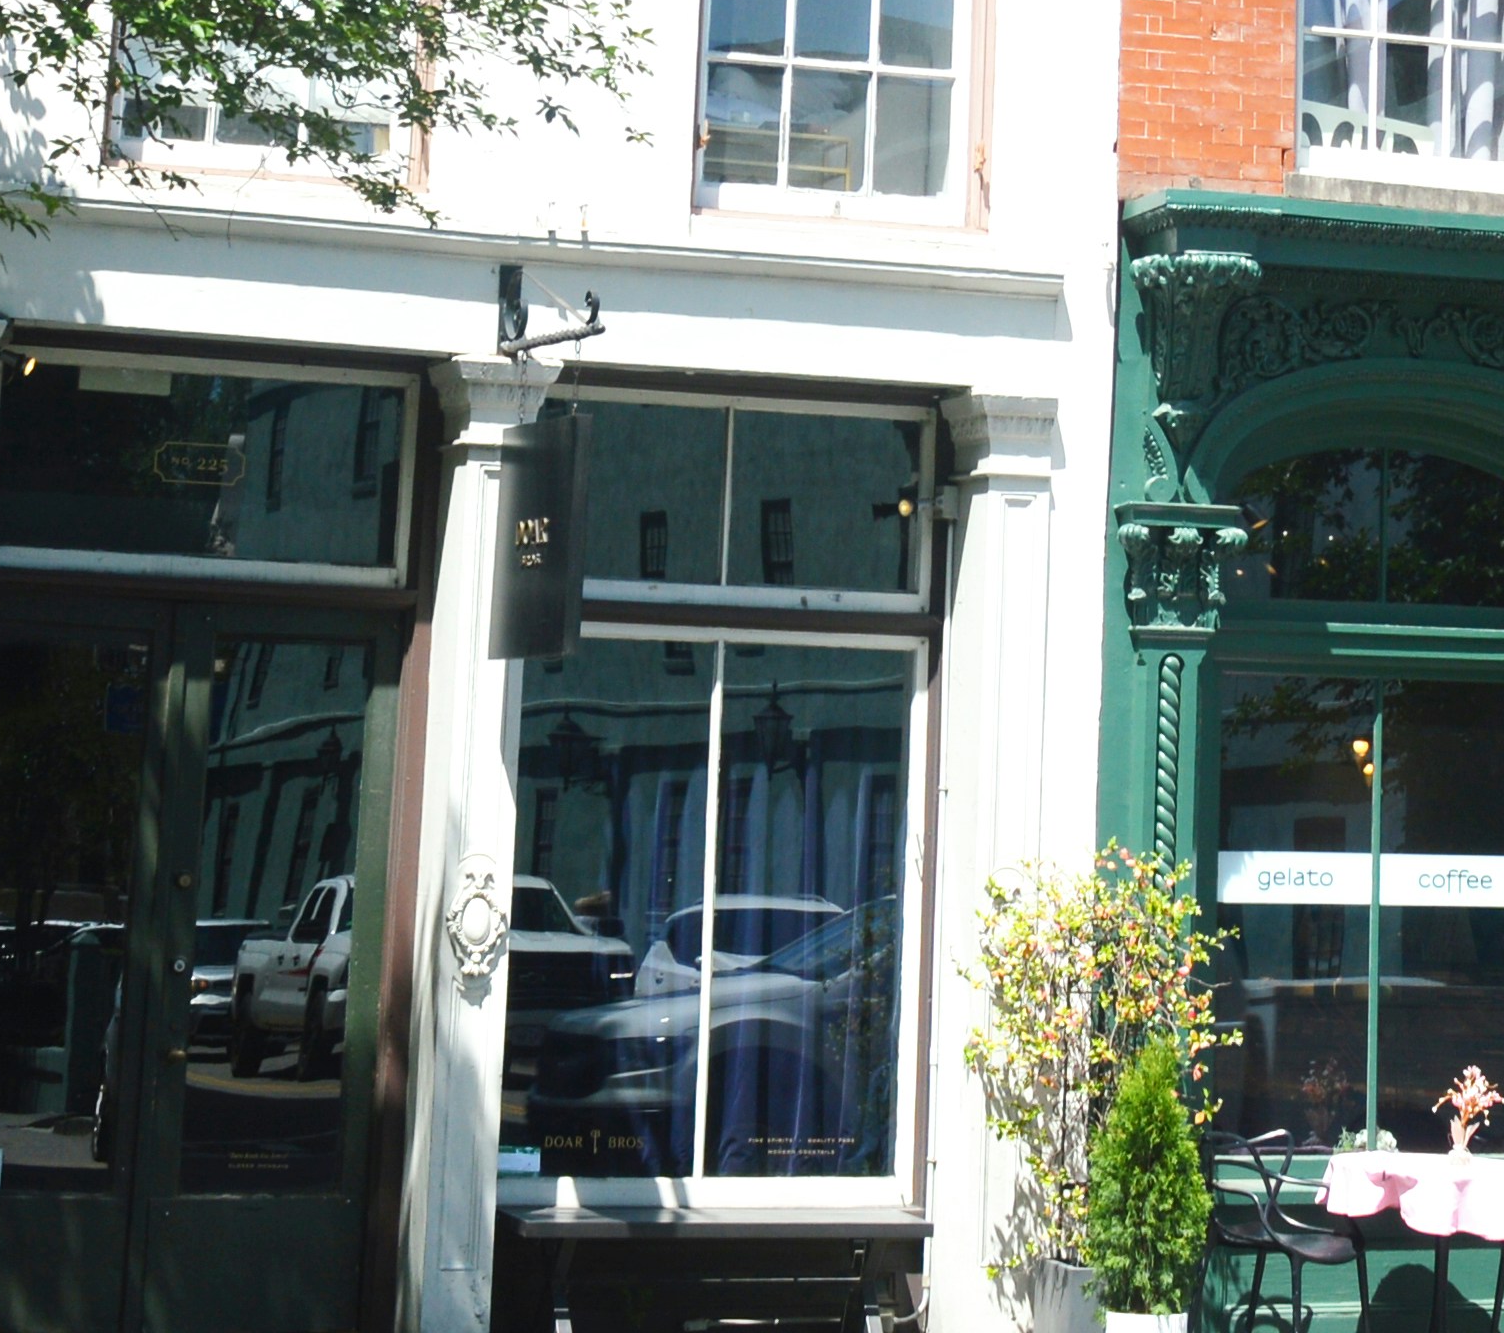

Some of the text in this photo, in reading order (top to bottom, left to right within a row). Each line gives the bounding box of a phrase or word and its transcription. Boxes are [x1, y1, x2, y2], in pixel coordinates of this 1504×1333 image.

[197, 456, 229, 476] 225
[1257, 867, 1334, 891] gelato
[1418, 869, 1493, 894] coffee
[545, 1135, 583, 1149] DOAR
